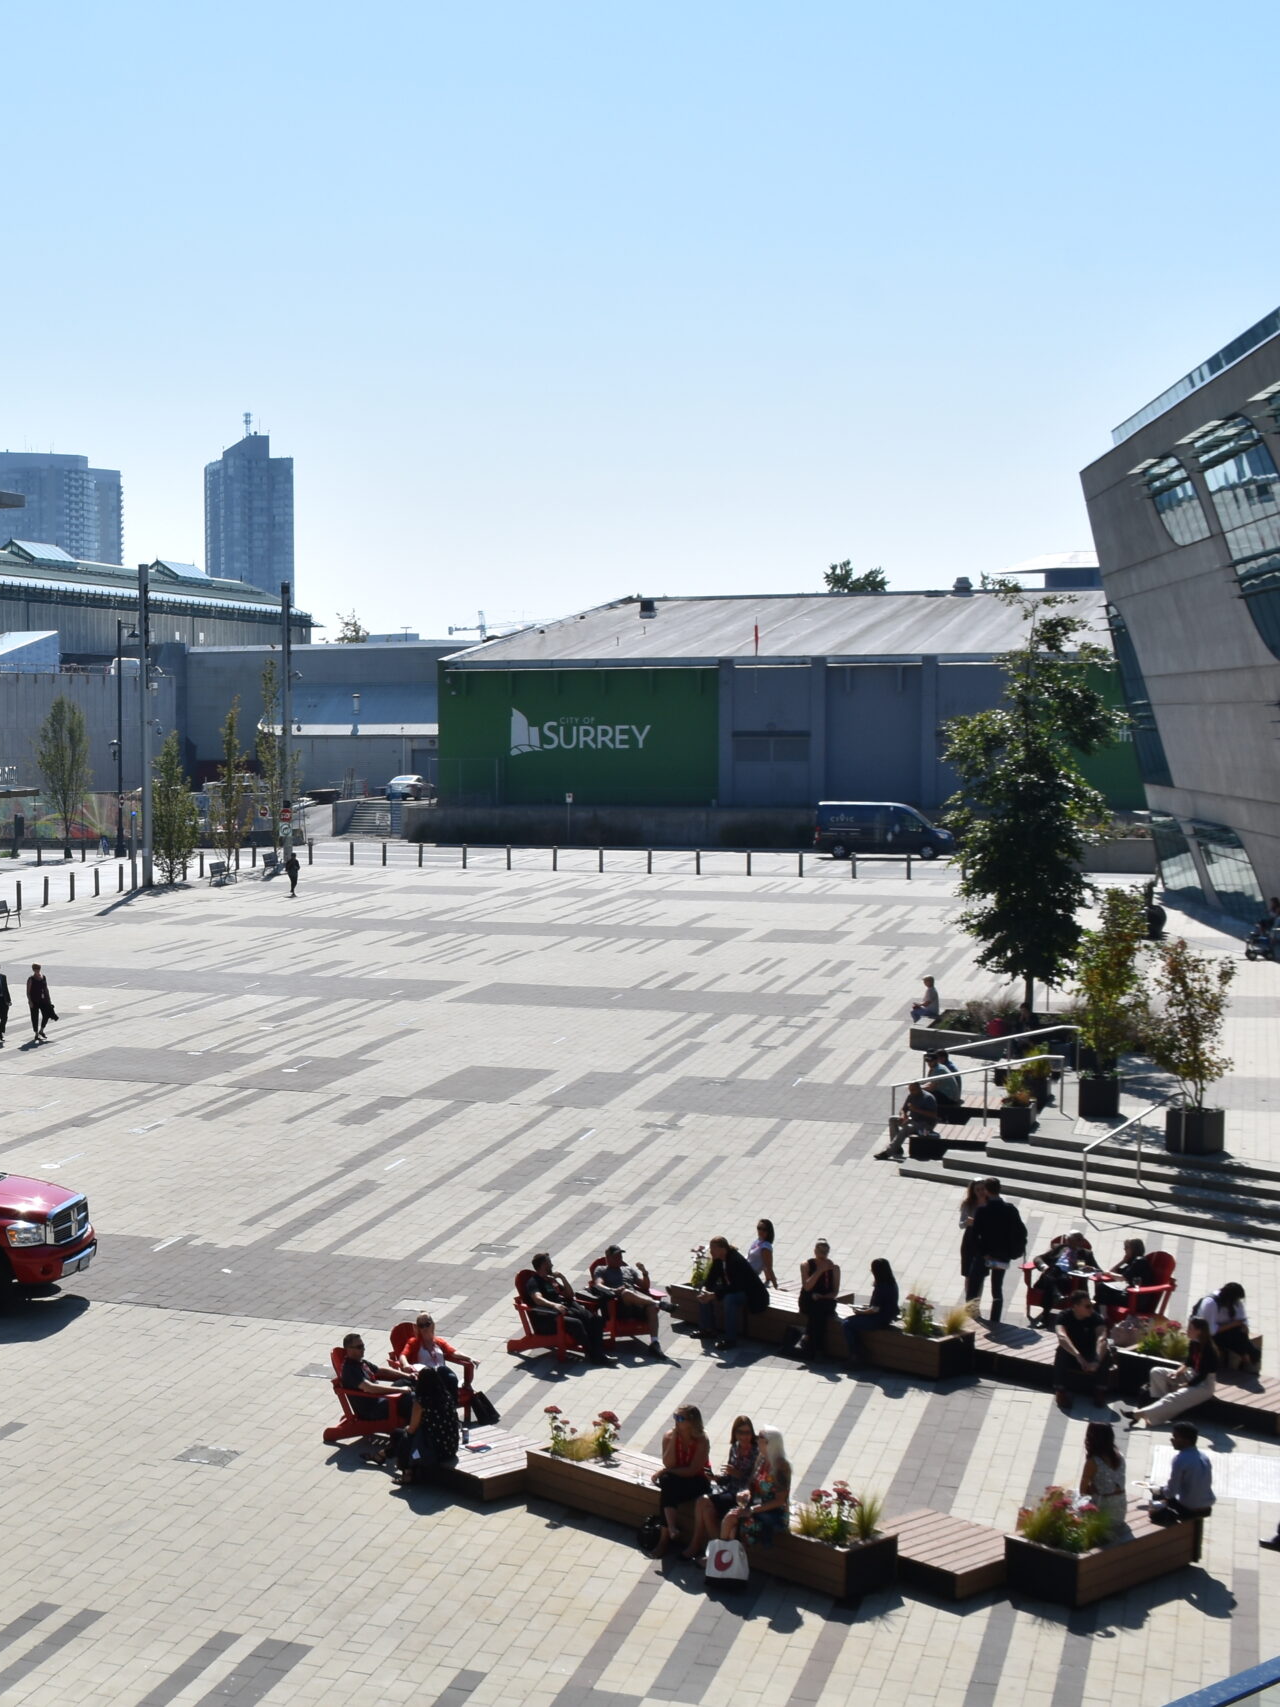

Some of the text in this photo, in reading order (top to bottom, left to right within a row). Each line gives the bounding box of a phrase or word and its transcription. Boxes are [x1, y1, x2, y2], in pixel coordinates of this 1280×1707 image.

[559, 717, 595, 725] CITY OF
[543, 721, 651, 750] SURREY
